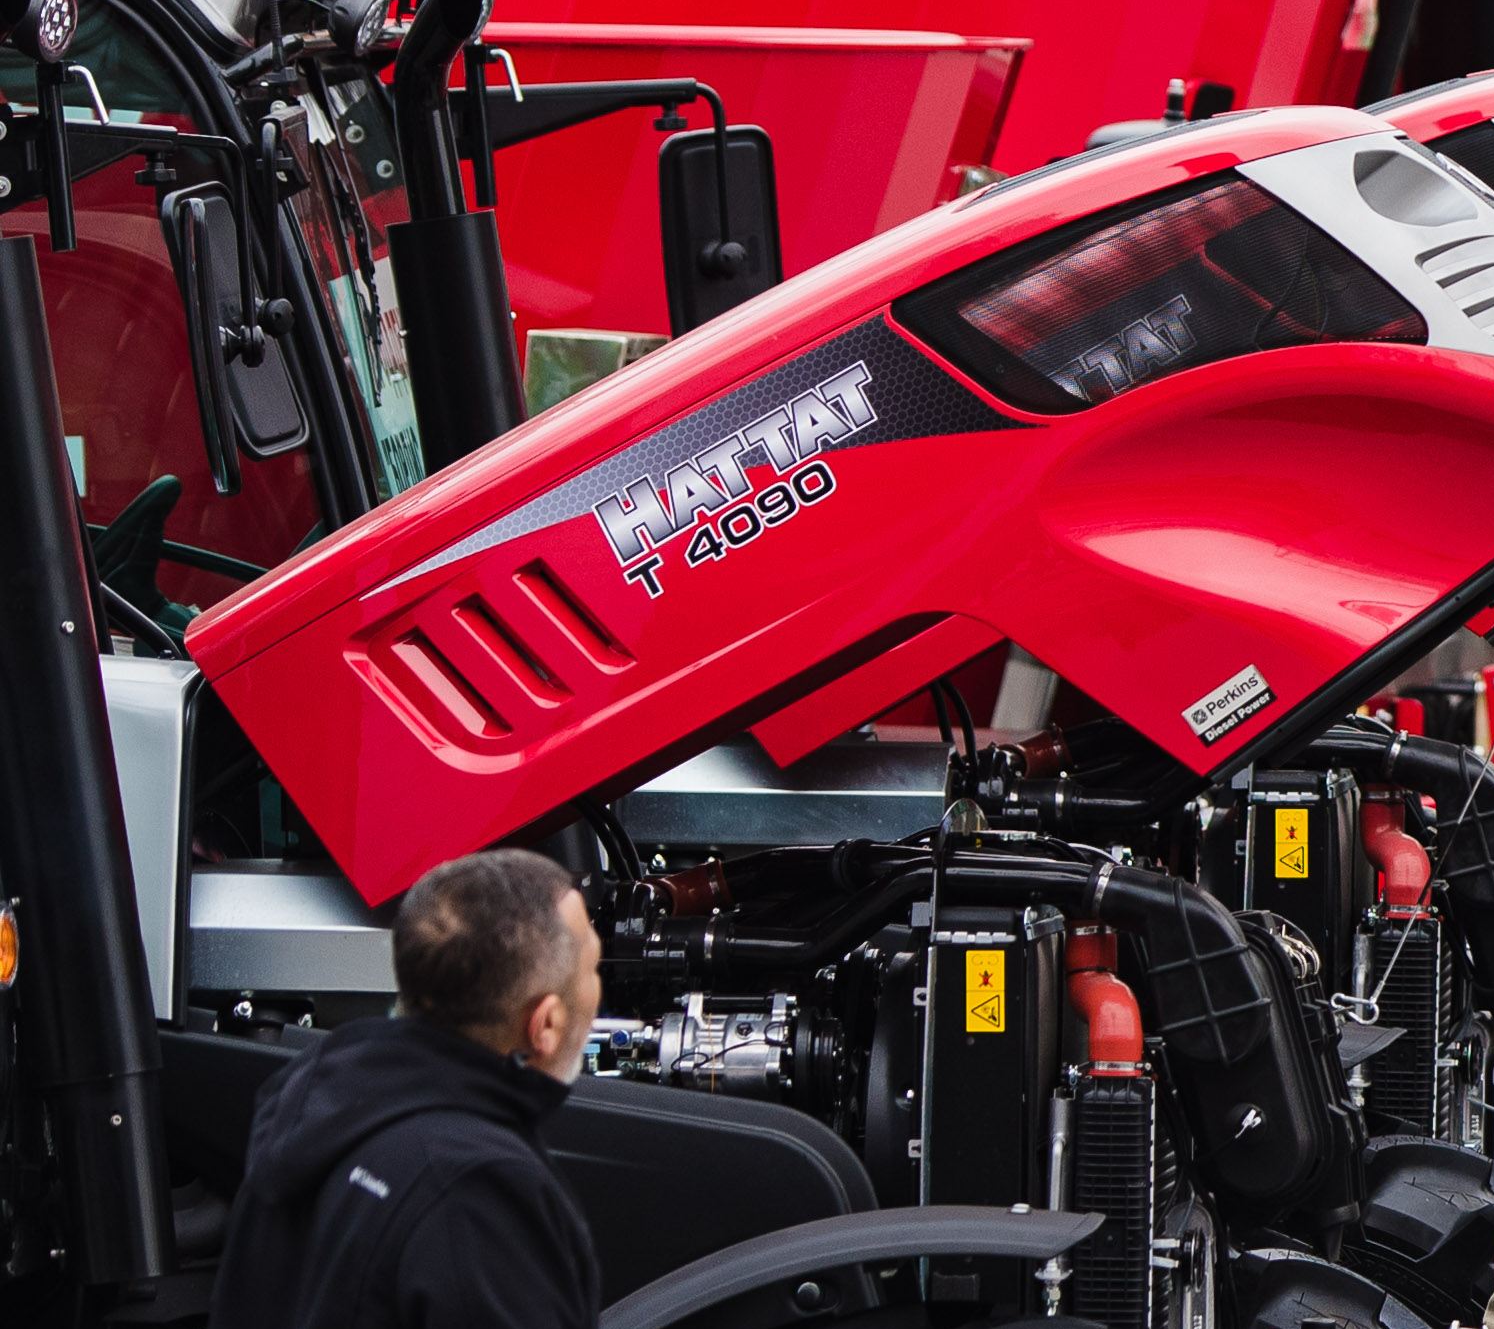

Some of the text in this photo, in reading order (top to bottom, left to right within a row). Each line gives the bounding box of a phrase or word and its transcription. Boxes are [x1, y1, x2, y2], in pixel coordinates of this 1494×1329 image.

[591, 360, 878, 567] HATTAT
[623, 460, 837, 599] T 4090
[1204, 692, 1271, 742] Diesel Power
